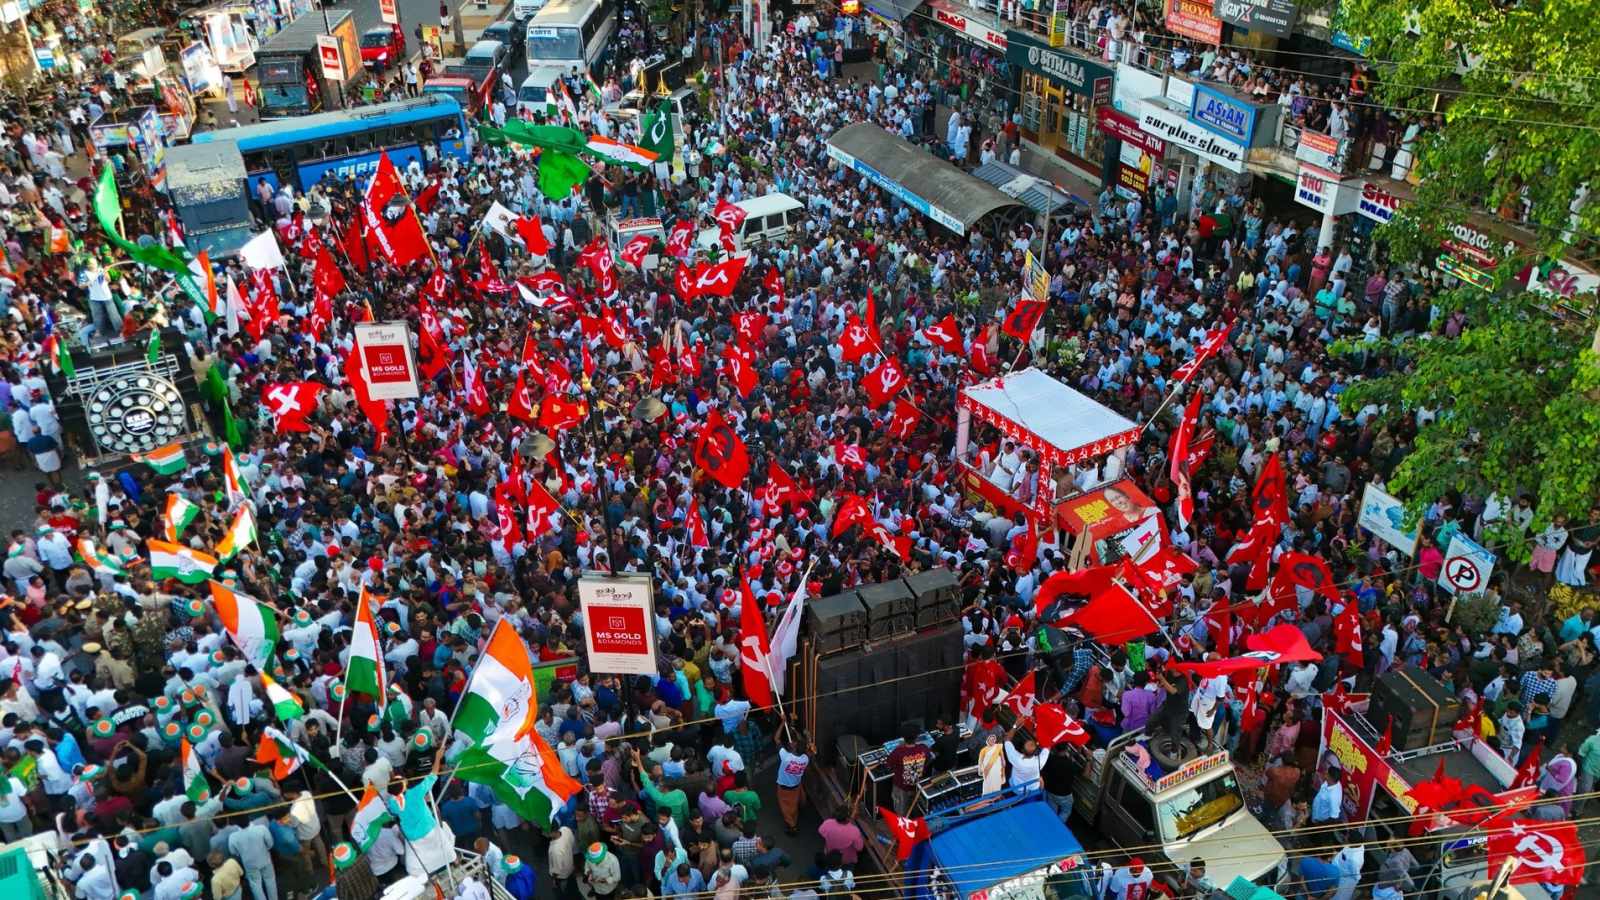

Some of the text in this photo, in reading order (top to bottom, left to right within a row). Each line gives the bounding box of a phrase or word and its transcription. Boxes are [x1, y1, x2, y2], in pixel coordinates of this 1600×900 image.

[1040, 49, 1085, 82] SITHARA
[1206, 99, 1245, 126] ASIAN
[1145, 115, 1197, 143] surplus
[1145, 136, 1162, 152] ATM
[596, 631, 641, 640] MS GOLD
